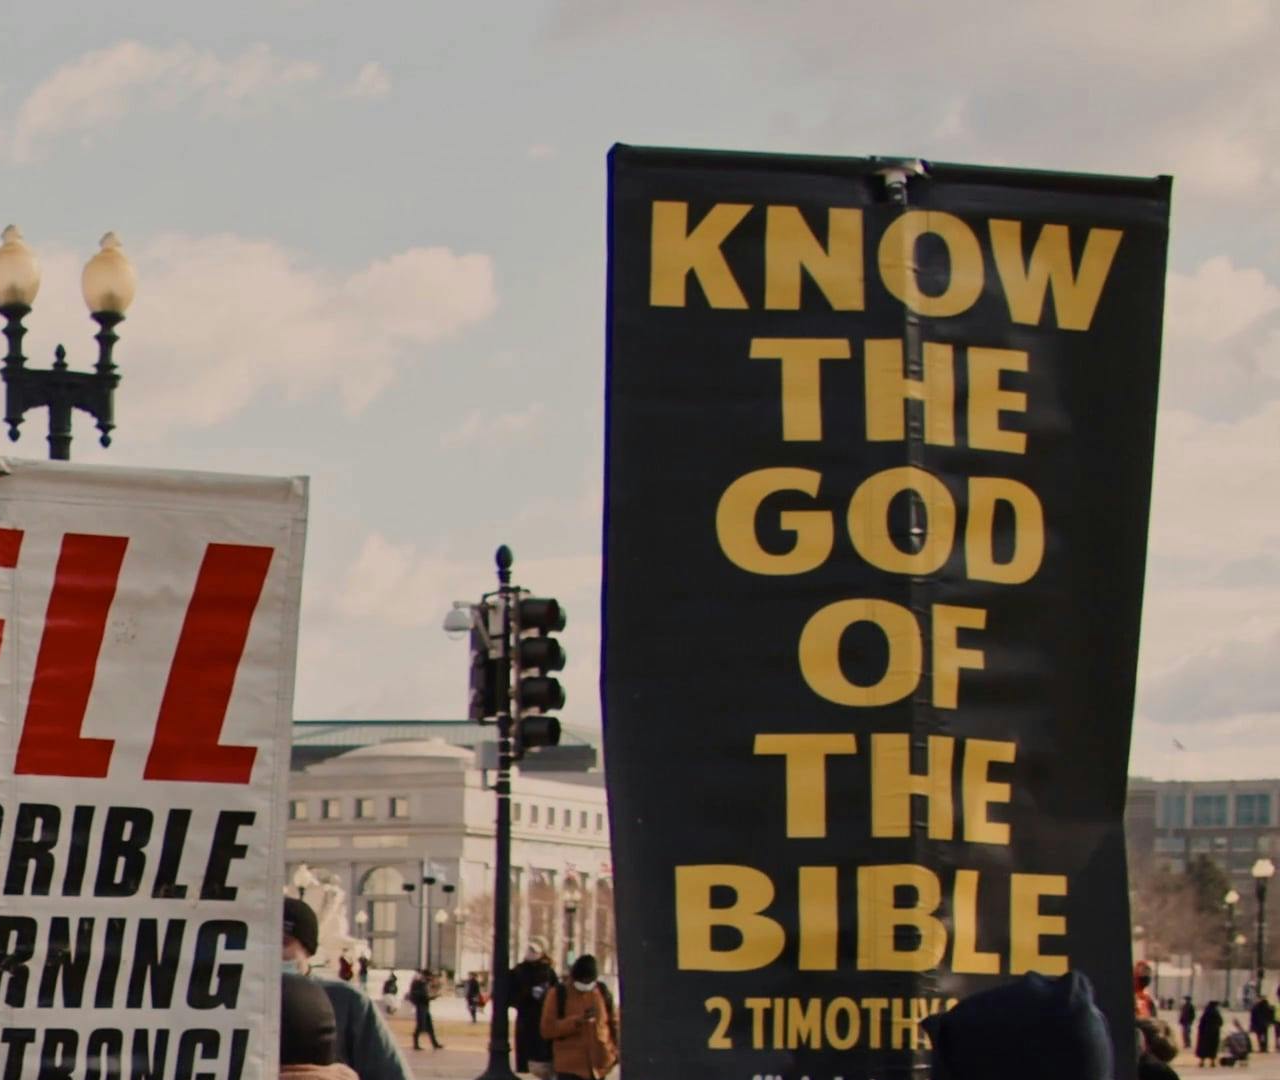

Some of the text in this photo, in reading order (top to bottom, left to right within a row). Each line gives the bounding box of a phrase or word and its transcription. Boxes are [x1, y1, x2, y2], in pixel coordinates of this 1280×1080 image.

[649, 200, 1124, 331] KNOW
[749, 338, 1028, 454] THE
[716, 466, 1045, 584] GOD
[798, 598, 987, 709] OF
[753, 733, 1016, 845] THE
[675, 864, 1069, 975] BIBLE
[704, 996, 733, 1049] 2
